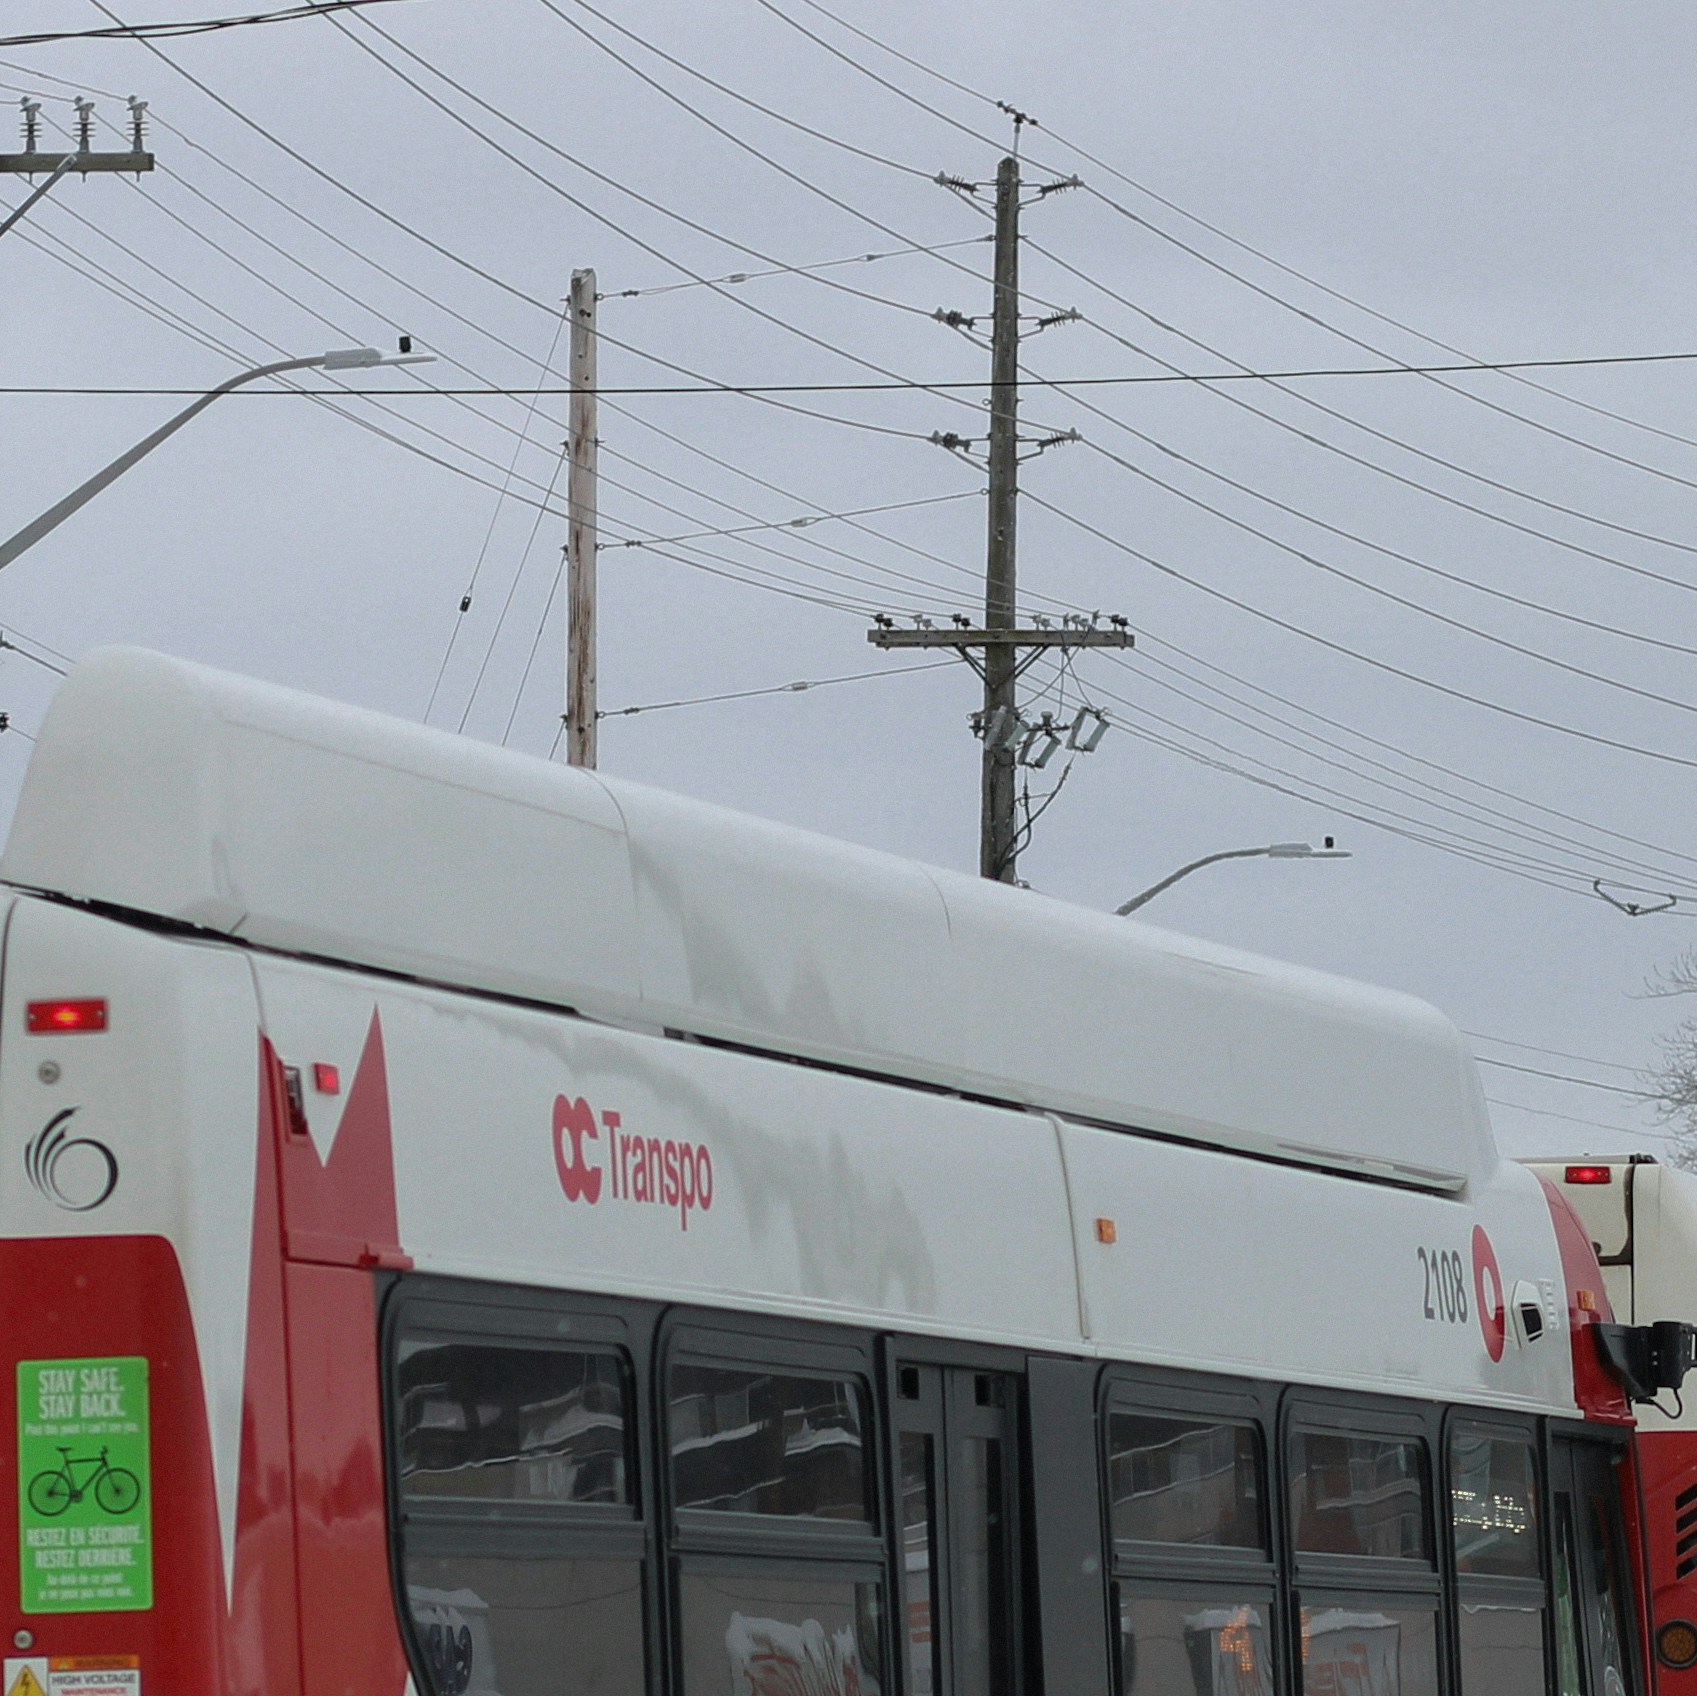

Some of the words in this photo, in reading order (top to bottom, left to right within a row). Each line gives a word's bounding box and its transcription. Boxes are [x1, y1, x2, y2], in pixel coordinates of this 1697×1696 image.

[552, 1093, 602, 1205] OC
[601, 1110, 712, 1231] Transpo
[1417, 1246, 1467, 1324] 2108
[38, 1369, 75, 1394] STAY
[80, 1367, 125, 1392] SAFE.
[38, 1395, 75, 1419] STAY
[80, 1393, 126, 1417] BACK.
[26, 1528, 67, 1547] RESTEZ
[69, 1527, 85, 1546] EN
[35, 1550, 75, 1568] RESTEZ
[52, 1674, 82, 1685] HIGH
[84, 1673, 136, 1685] VOLTAGE
